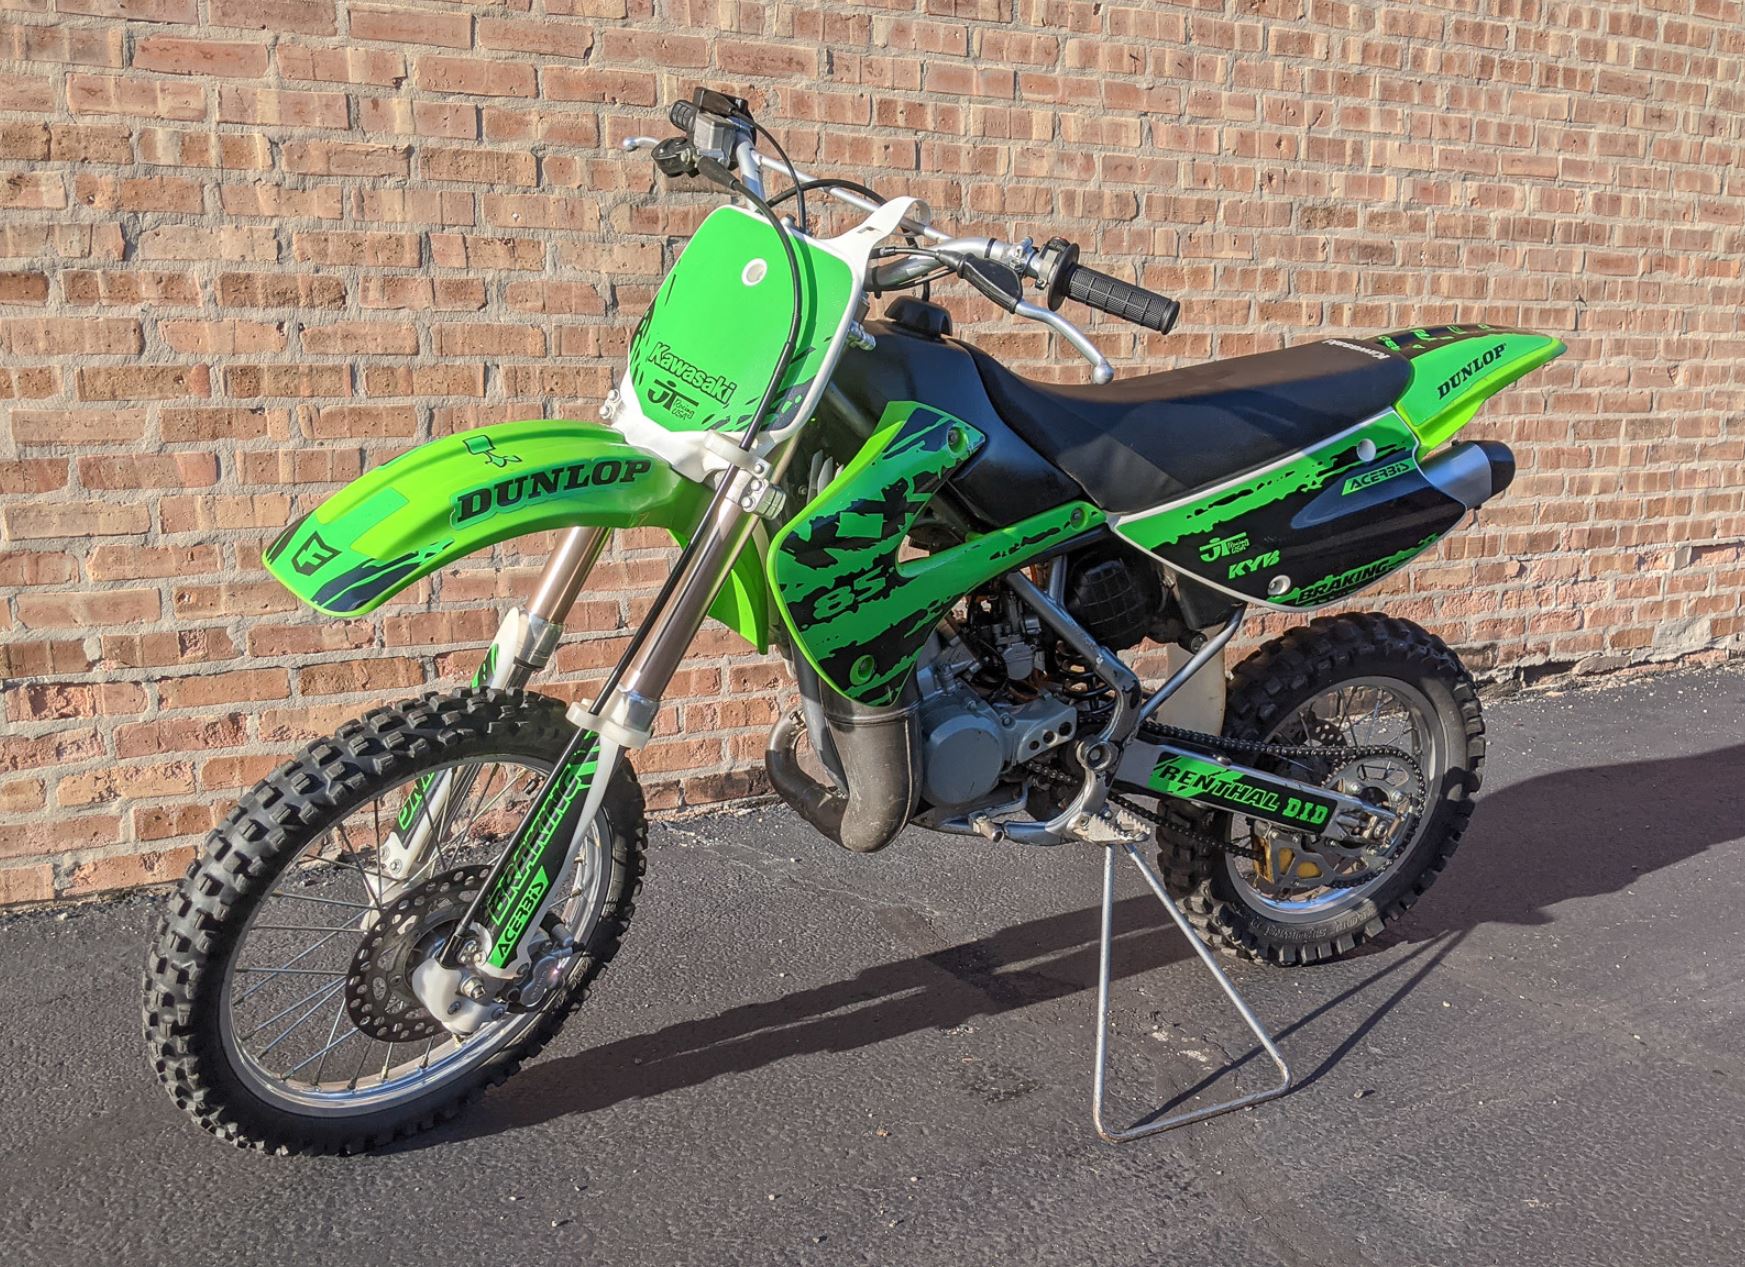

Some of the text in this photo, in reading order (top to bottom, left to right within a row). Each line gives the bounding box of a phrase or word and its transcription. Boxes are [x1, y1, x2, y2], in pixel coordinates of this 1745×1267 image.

[648, 341, 737, 405] Kawasaki
[1438, 343, 1505, 399] DUNLOP
[647, 379, 699, 411] JT
[456, 460, 651, 523] DUNLOP
[1199, 532, 1247, 562] JT
[1228, 549, 1280, 579] KYB
[1298, 560, 1391, 603] BRAKING
[1158, 765, 1280, 812] RENTHAL
[487, 764, 581, 926] BRAKING
